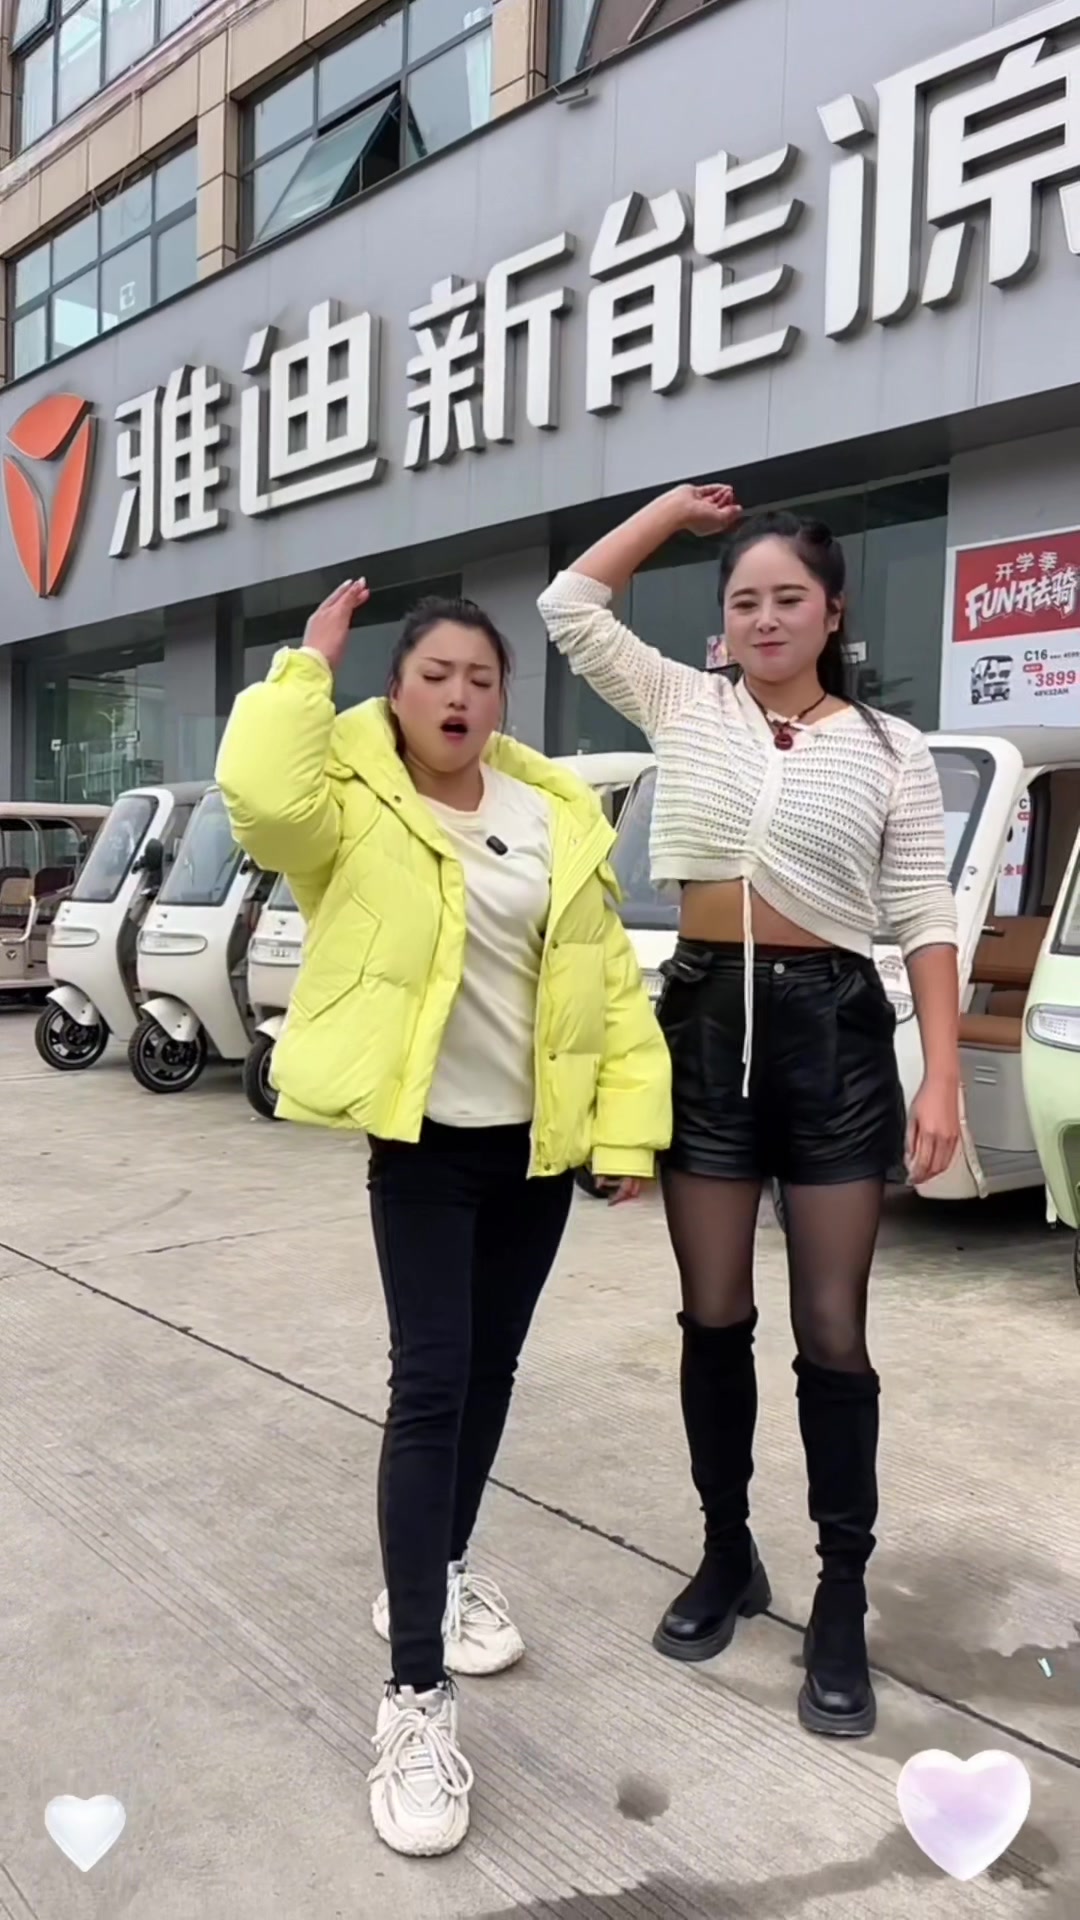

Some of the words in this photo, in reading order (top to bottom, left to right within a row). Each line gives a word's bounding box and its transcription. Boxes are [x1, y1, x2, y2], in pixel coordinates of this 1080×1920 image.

[108, 0, 1080, 557] 雅迪新能源
[995, 551, 1057, 582] 开学季
[1024, 649, 1048, 662] C16
